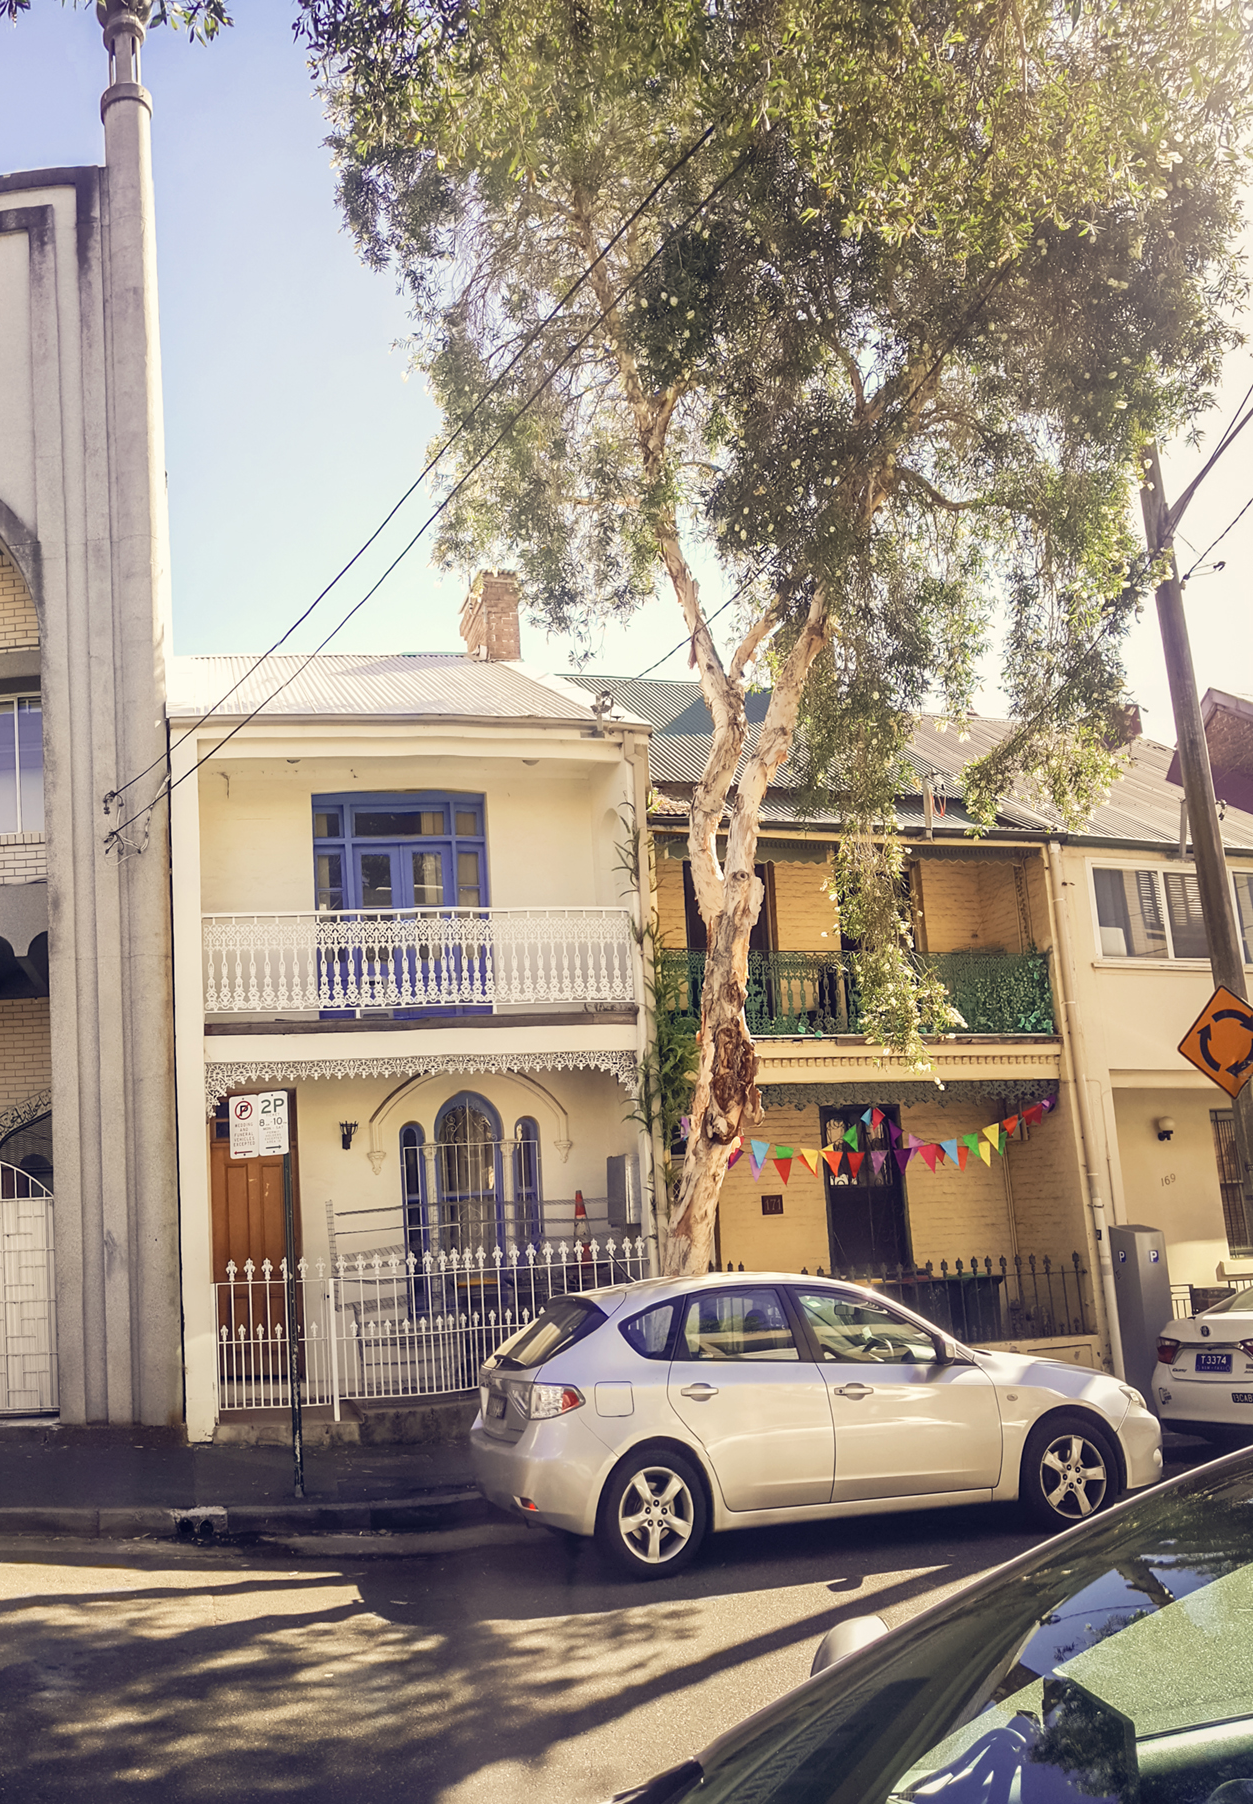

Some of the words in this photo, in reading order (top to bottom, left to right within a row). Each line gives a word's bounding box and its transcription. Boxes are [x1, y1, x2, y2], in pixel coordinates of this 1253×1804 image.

[261, 1098, 284, 1114] 2P
[1160, 1173, 1176, 1187] 169
[765, 1198, 781, 1211] 171
